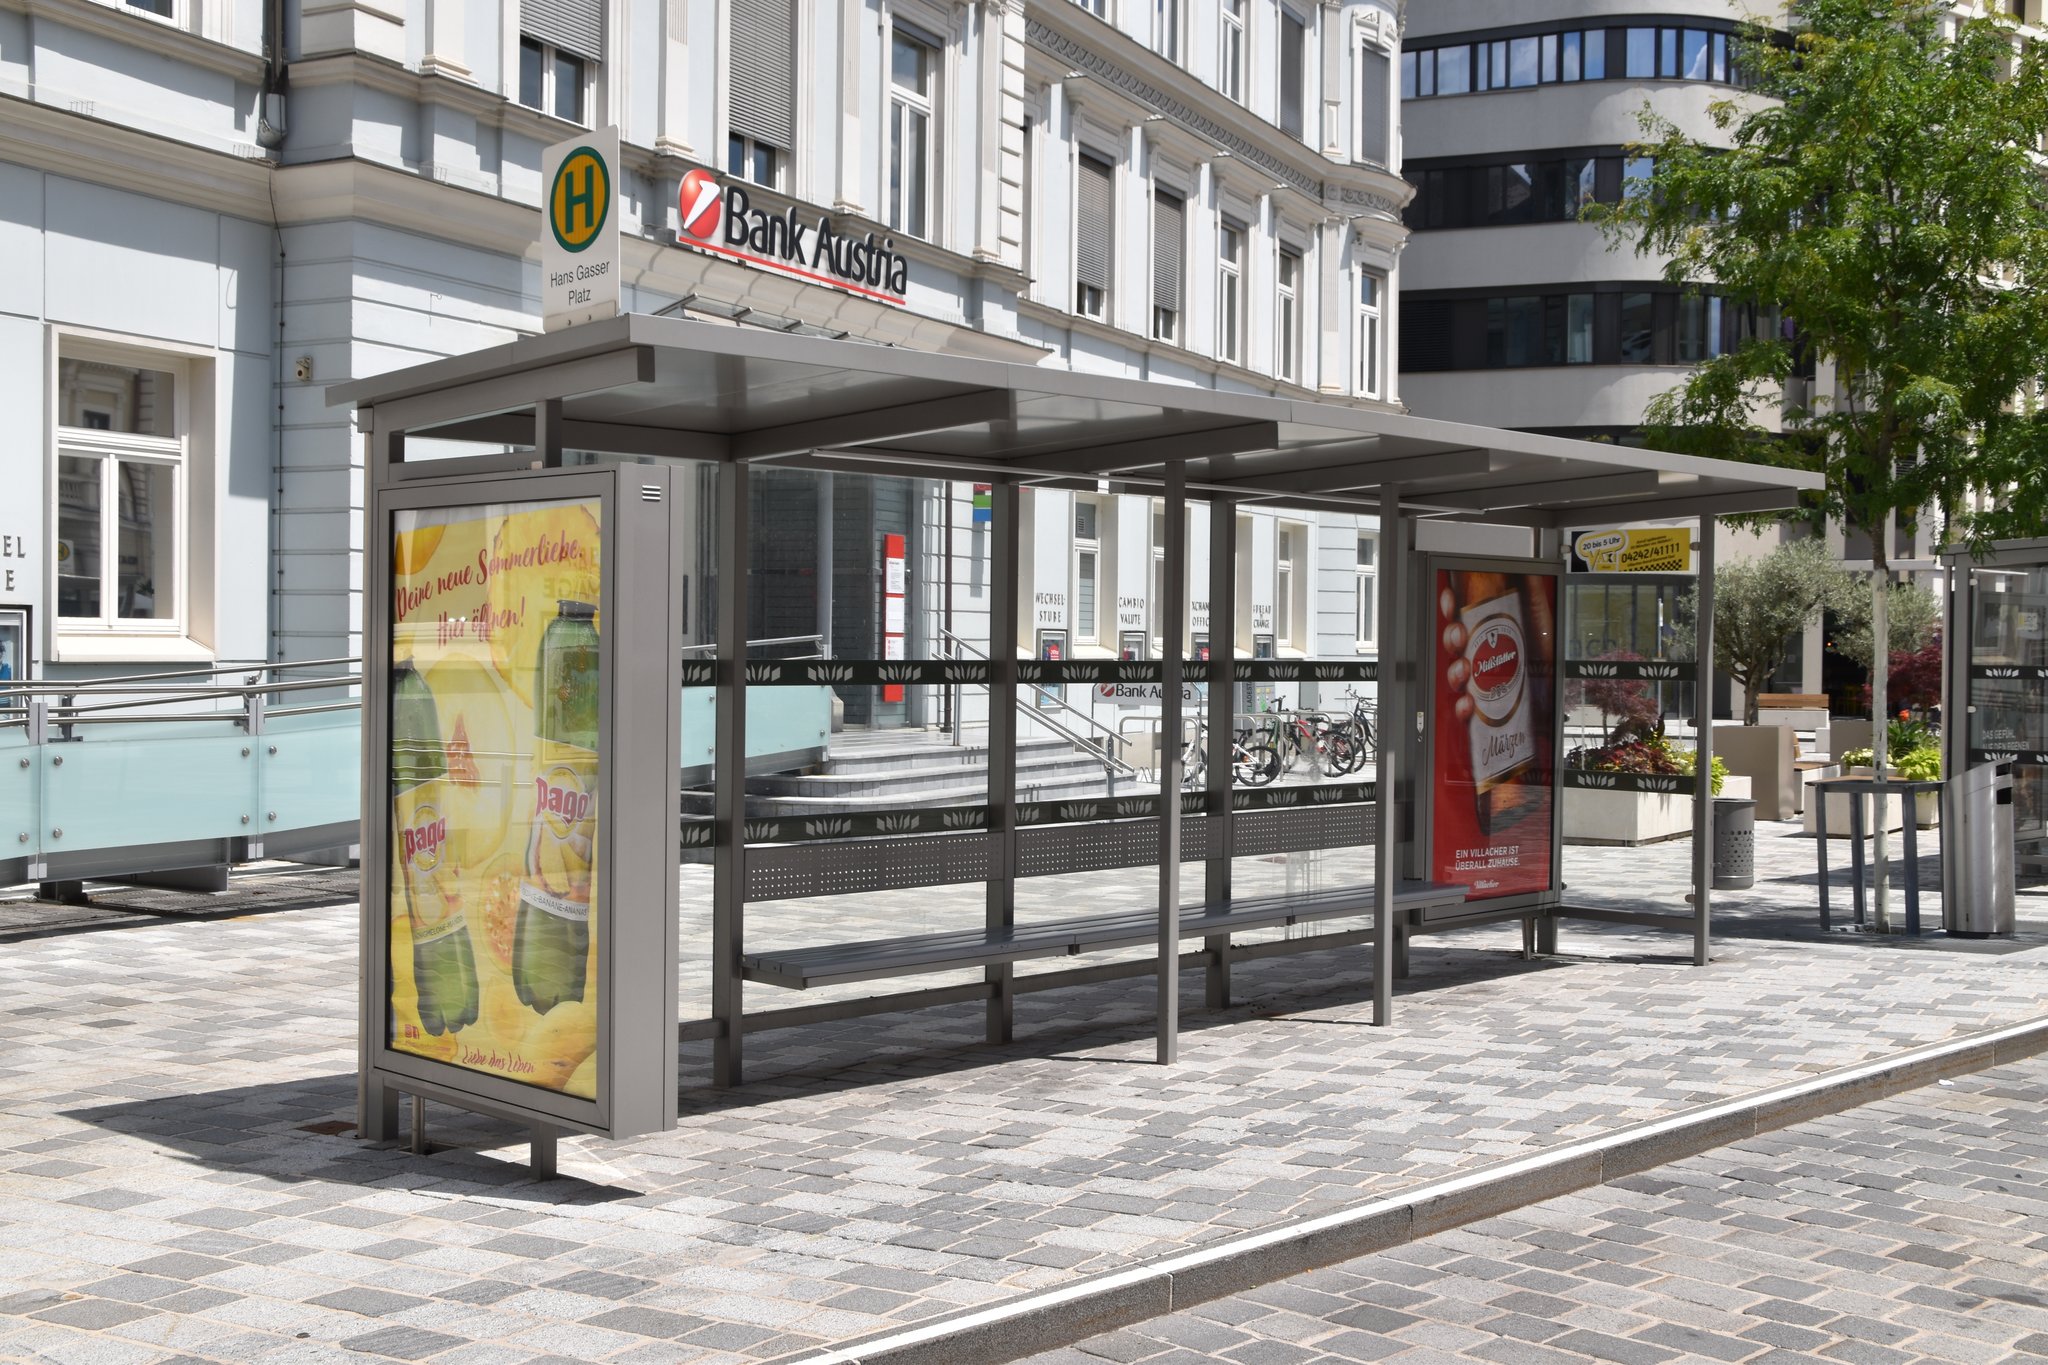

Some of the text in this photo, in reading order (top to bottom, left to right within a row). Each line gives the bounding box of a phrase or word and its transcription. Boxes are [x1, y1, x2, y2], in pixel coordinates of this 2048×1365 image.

[565, 164, 594, 234] H
[724, 186, 908, 296] Bank Austria
[550, 261, 610, 288] Hans Gasser
[568, 288, 591, 306] Platz
[3, 535, 26, 559] EL
[1621, 542, 1680, 563] 04242/41111
[395, 529, 584, 622] Deine neue Sommerliebe.
[1118, 597, 1145, 609] CAMBIO
[438, 596, 526, 649] Hier öffnen!
[1039, 610, 1061, 623] STUBE
[1120, 613, 1141, 625] VALUTE
[1115, 683, 1147, 697] Bank
[1482, 731, 1525, 766] Märzen
[404, 817, 447, 864] pago
[1455, 845, 1520, 859] EIN VILLACHER IST
[1455, 857, 1520, 871] ÜBERALL ZUHAUSE.
[462, 1044, 486, 1065] Liebe
[488, 1048, 505, 1070] das
[507, 1051, 536, 1073] Leben
